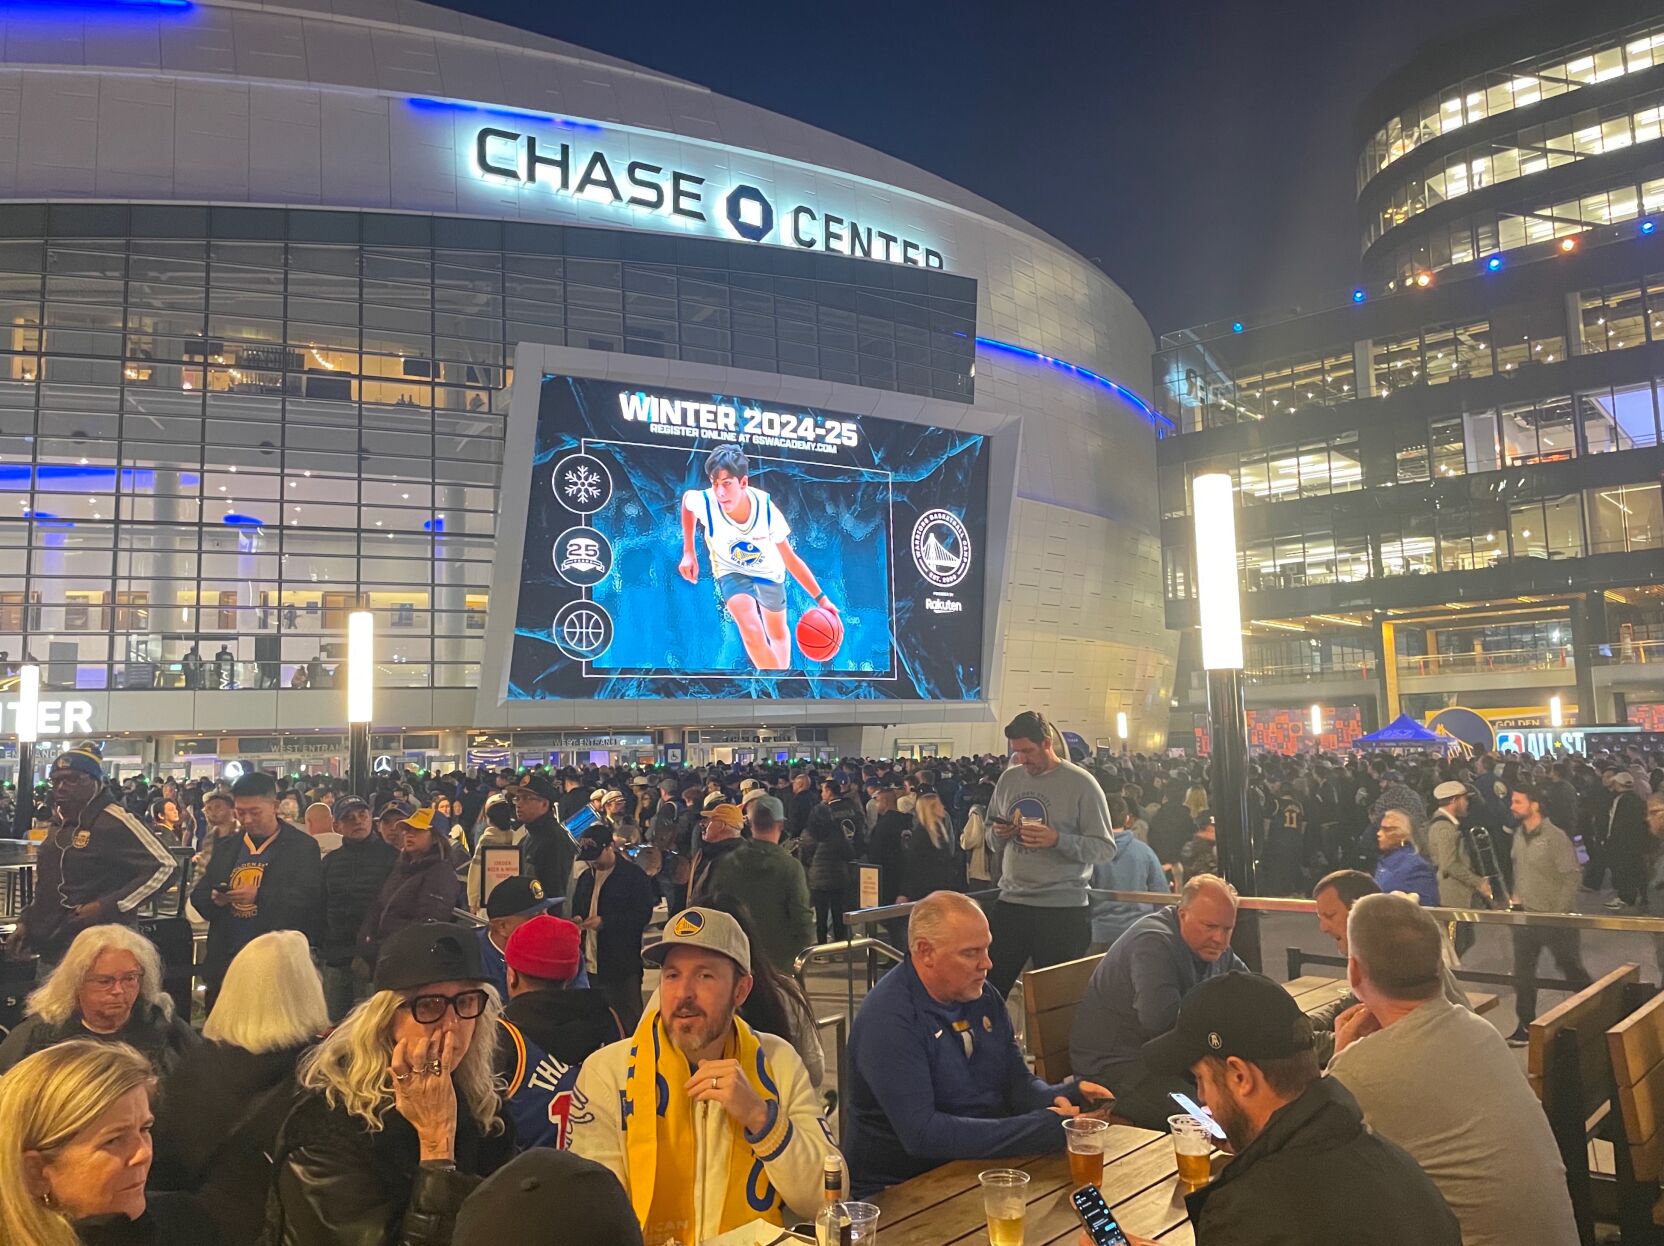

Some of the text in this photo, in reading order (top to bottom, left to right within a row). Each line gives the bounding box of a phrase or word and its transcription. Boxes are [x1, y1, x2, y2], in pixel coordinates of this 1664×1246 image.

[477, 127, 707, 222] CHASE
[618, 392, 858, 447] WINTER 2024-25
[650, 423, 838, 454] REGISTER ONLINE AT GSWACADEMY.COM
[914, 518, 930, 558] WARRIORS
[929, 512, 965, 539] BASKETBALL
[568, 543, 598, 557] 25
[925, 598, 962, 612] Rakuten
[271, 744, 300, 753] WEST
[1284, 811, 1297, 828] 11
